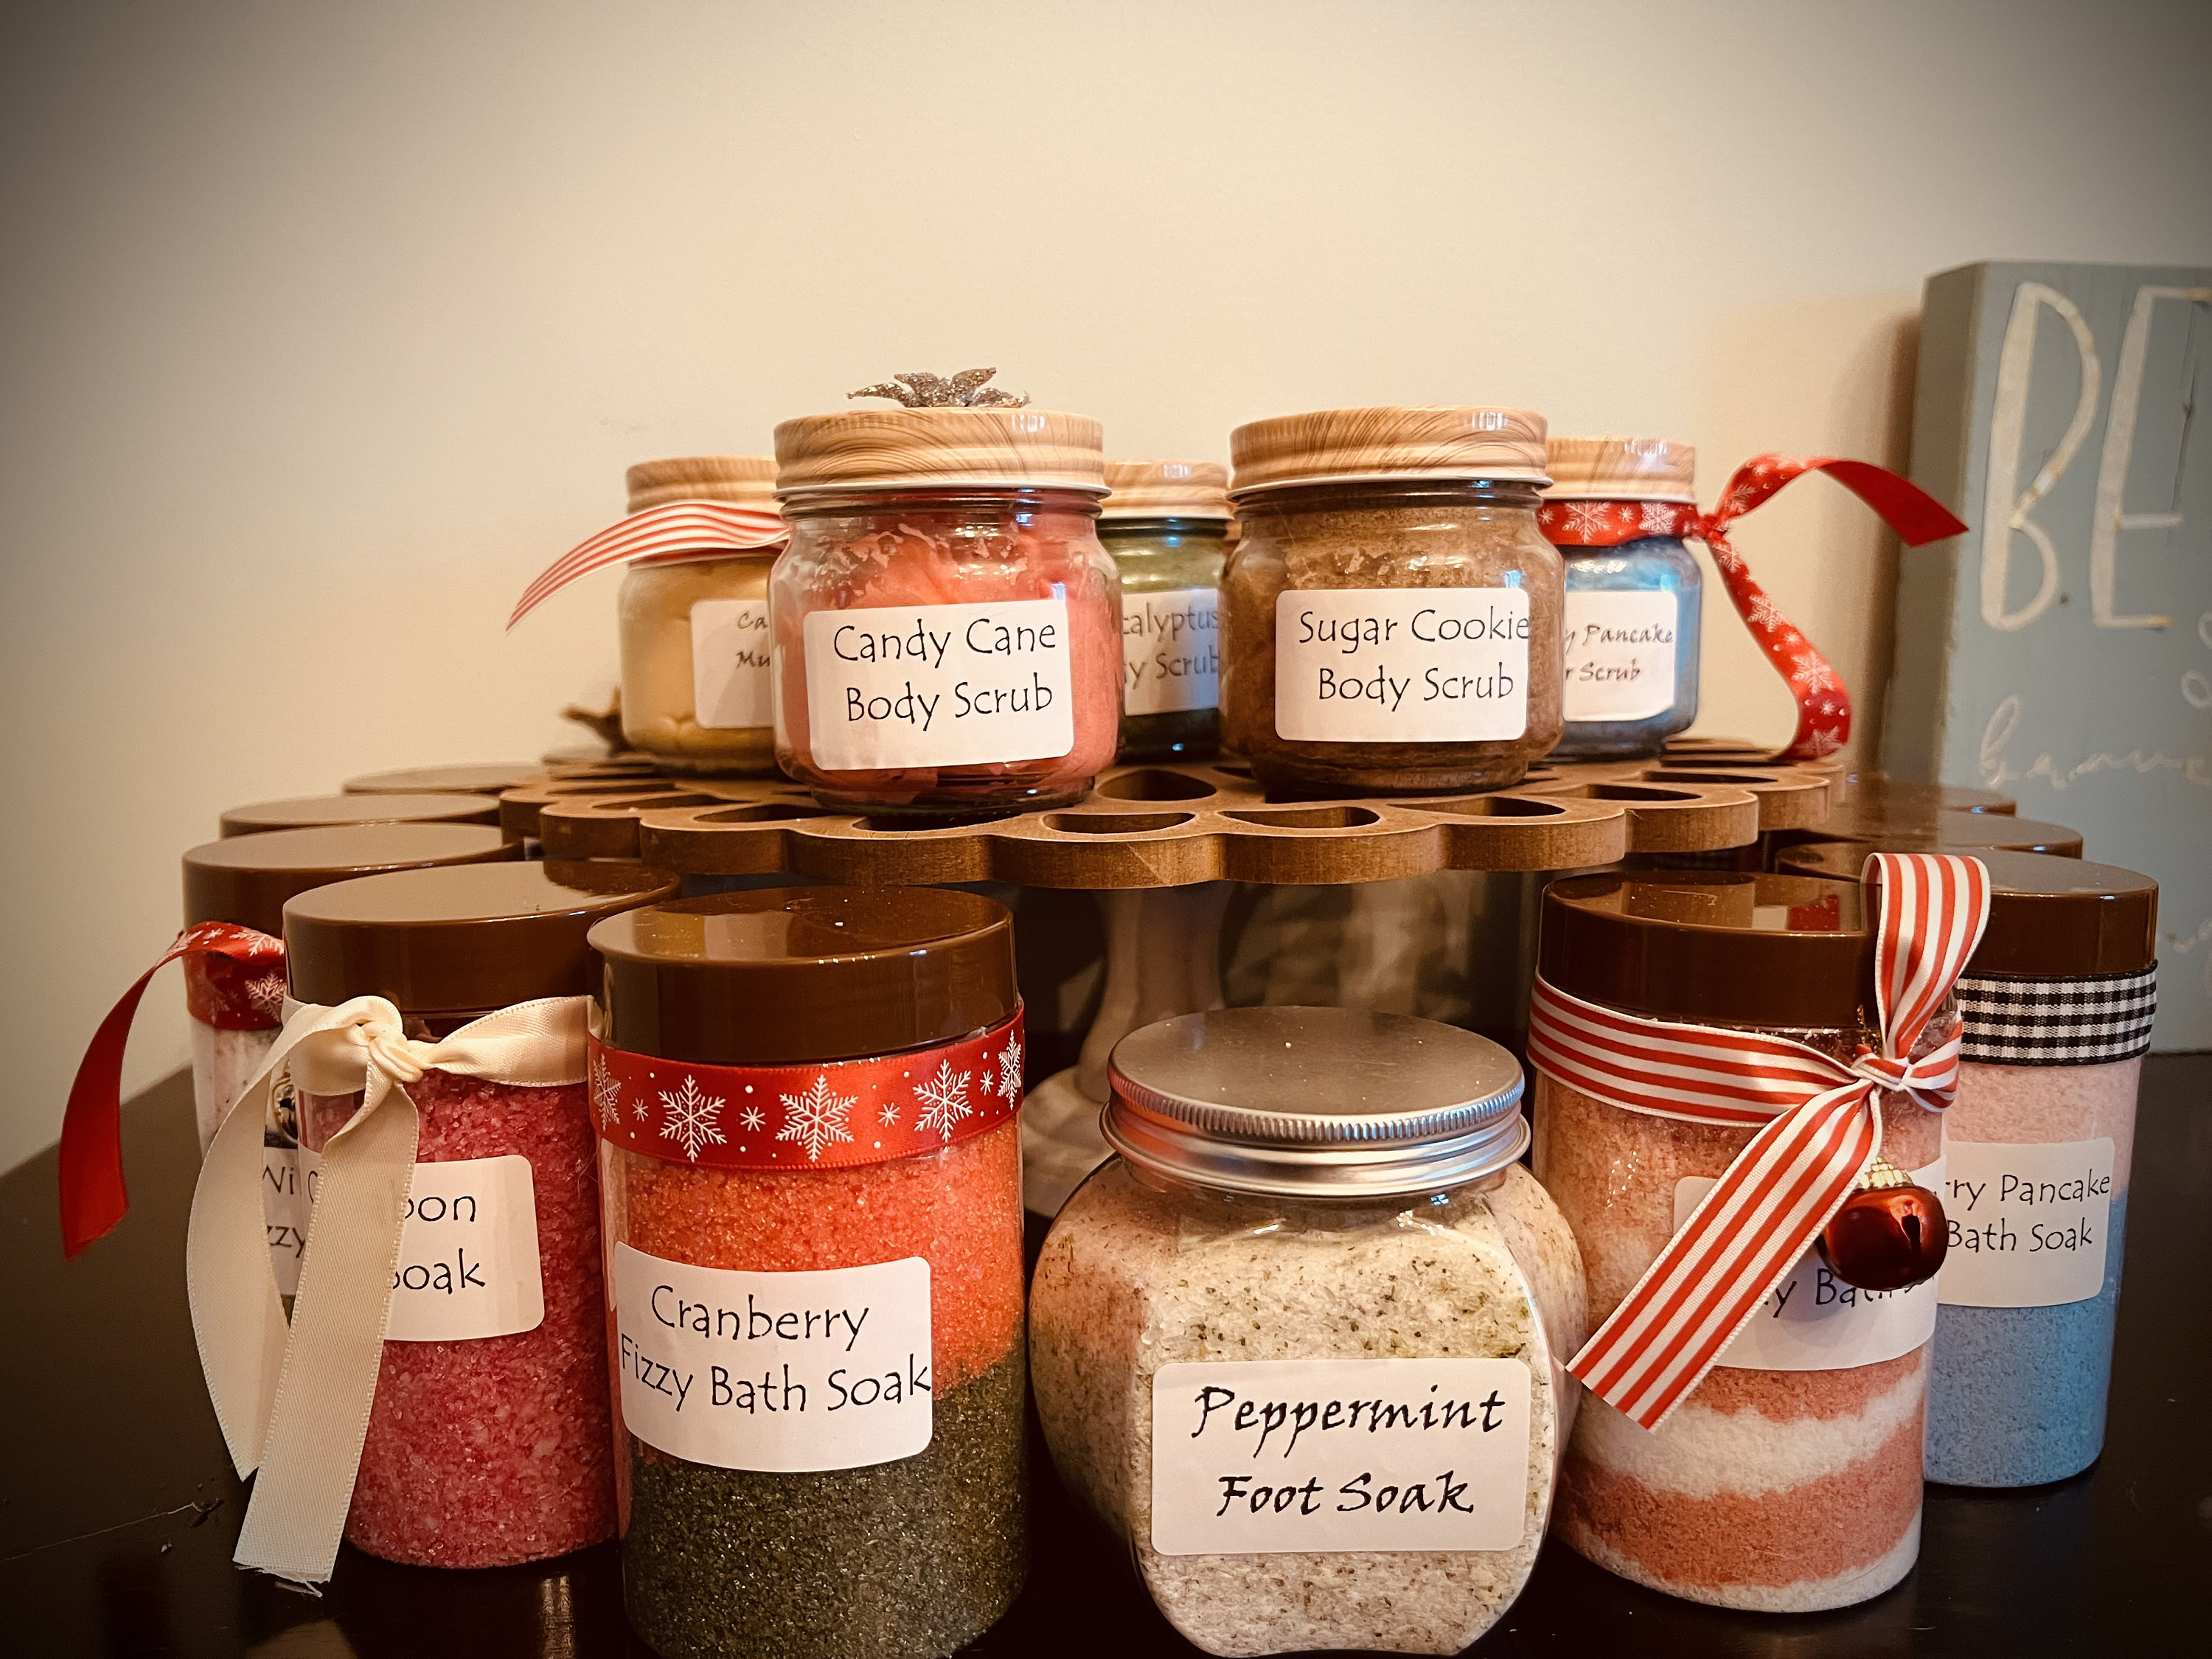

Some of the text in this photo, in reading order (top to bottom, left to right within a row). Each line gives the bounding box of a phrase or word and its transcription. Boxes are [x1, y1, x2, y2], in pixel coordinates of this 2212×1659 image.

[1980, 282, 2212, 630] BE
[833, 618, 1056, 668] Candy Cane
[1298, 611, 1397, 654] Sugar
[1411, 605, 1530, 642] Cookie
[1582, 623, 1674, 646] Pancake
[1155, 644, 1220, 679] Scrub
[1579, 658, 1641, 682] Scrub
[846, 672, 1053, 731] Body Scrub
[1318, 661, 1514, 712] Body Scrub
[2000, 1168, 2110, 1206] Pancake
[1947, 1217, 2093, 1253] Bath Soak
[393, 1248, 486, 1295] oak
[651, 1285, 869, 1352] Cranberry
[620, 1333, 932, 1415] Fizzy Bath Soak
[1191, 1384, 1506, 1458] Peppermint
[1216, 1470, 1474, 1517] Foot Soak
